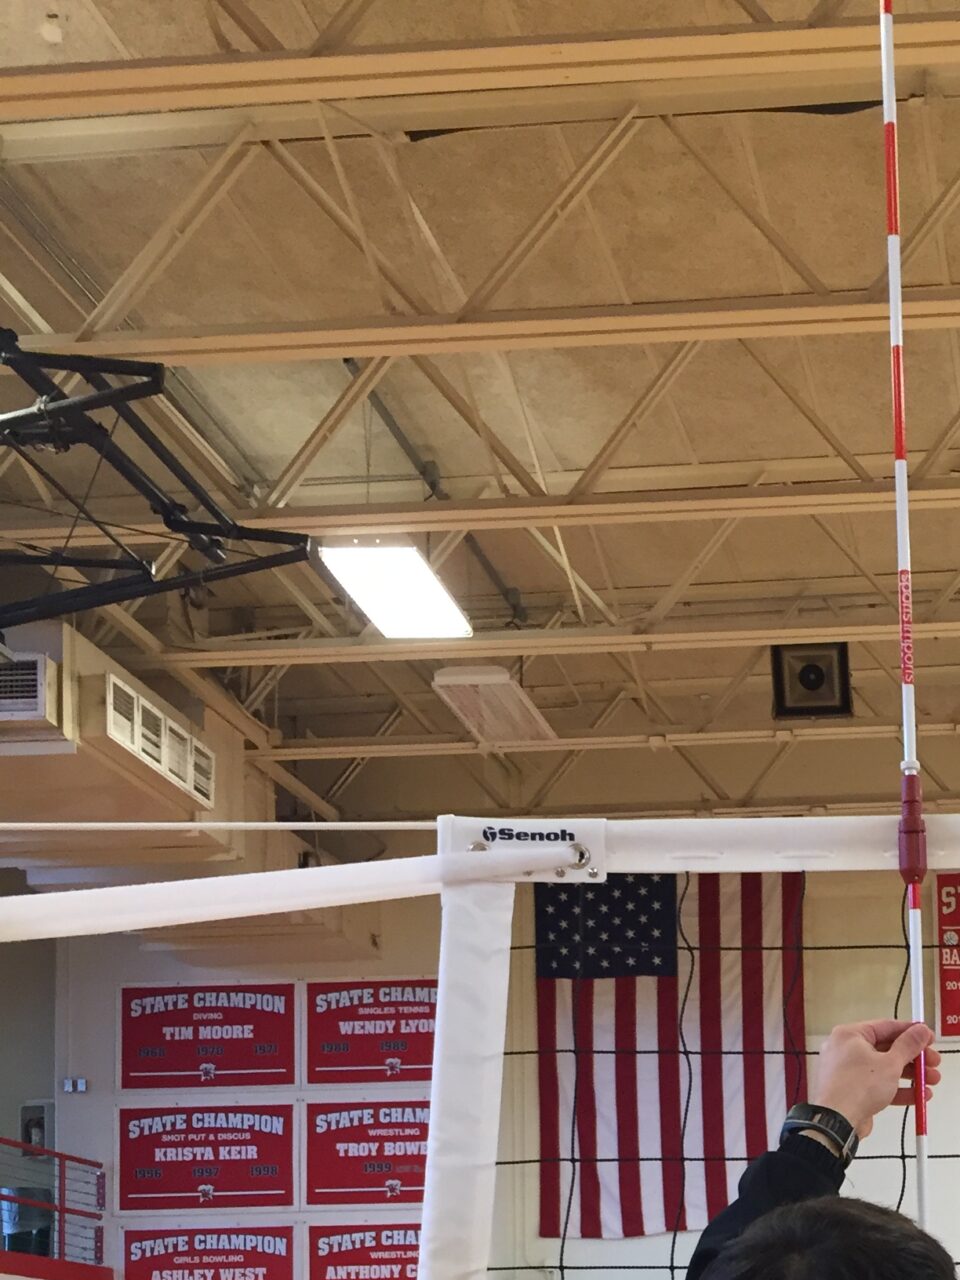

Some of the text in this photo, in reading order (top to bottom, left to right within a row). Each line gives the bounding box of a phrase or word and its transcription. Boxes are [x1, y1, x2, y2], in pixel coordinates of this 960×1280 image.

[498, 828, 575, 842] Senoh
[131, 992, 285, 1018] STATE CHAMPION
[316, 988, 374, 1014] STATE
[163, 1025, 254, 1040] TIM MOORE
[339, 1021, 395, 1034] WENDY
[129, 1113, 283, 1139] STATE CHAMPION
[316, 1109, 374, 1134] STATE
[161, 1134, 186, 1142] SHOT
[189, 1133, 205, 1141] PUT
[218, 1132, 251, 1141] DISCUS
[368, 1128, 420, 1137] WRESTLING
[155, 1146, 257, 1161] KRISTA KEIR
[336, 1143, 379, 1157] TROY
[131, 1235, 287, 1261] STATE CHAMPION
[318, 1230, 421, 1257] STATE CHA
[174, 1254, 244, 1263] GIRLS BOWLING
[326, 1266, 401, 1280] ANTHONY
